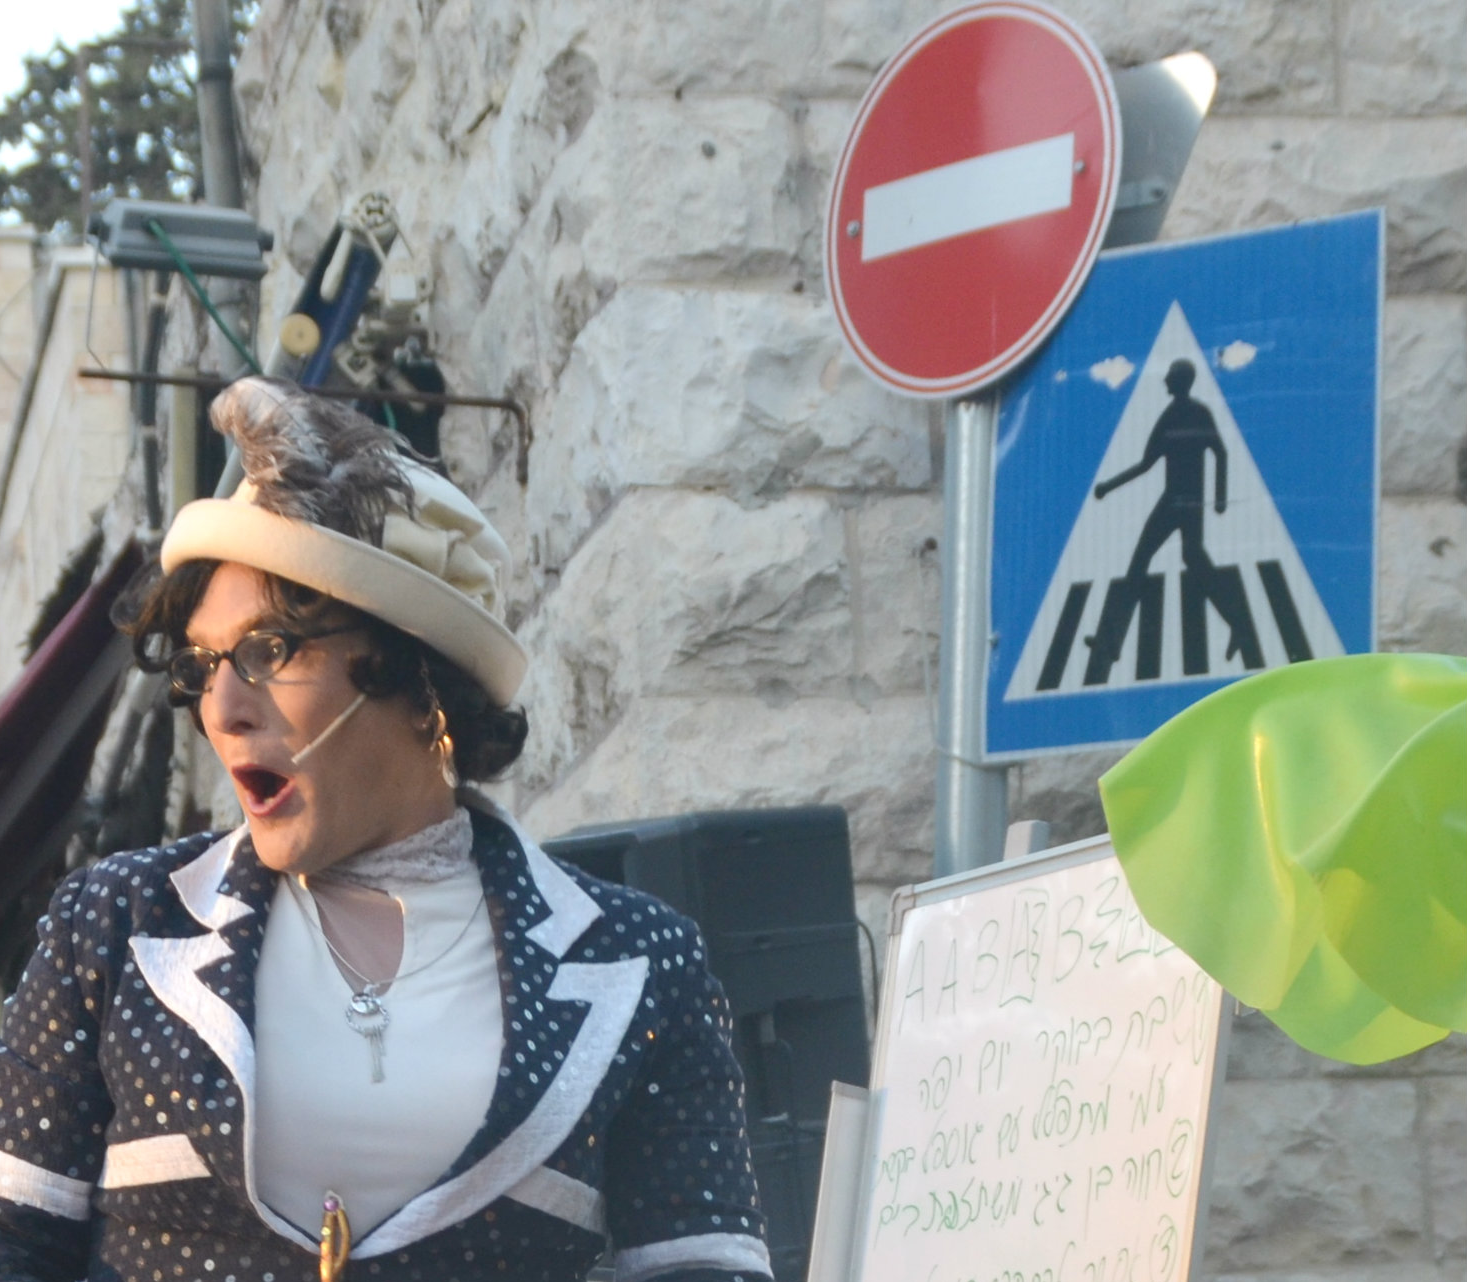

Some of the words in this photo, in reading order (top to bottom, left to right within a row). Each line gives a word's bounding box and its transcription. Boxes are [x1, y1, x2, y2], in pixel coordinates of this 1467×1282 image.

[1035, 1015, 1113, 1086] בבוקר
[1100, 976, 1193, 1084] שבת
[919, 1053, 963, 1112] יפה
[978, 1039, 1011, 1095] יום
[997, 1104, 1024, 1160] עם
